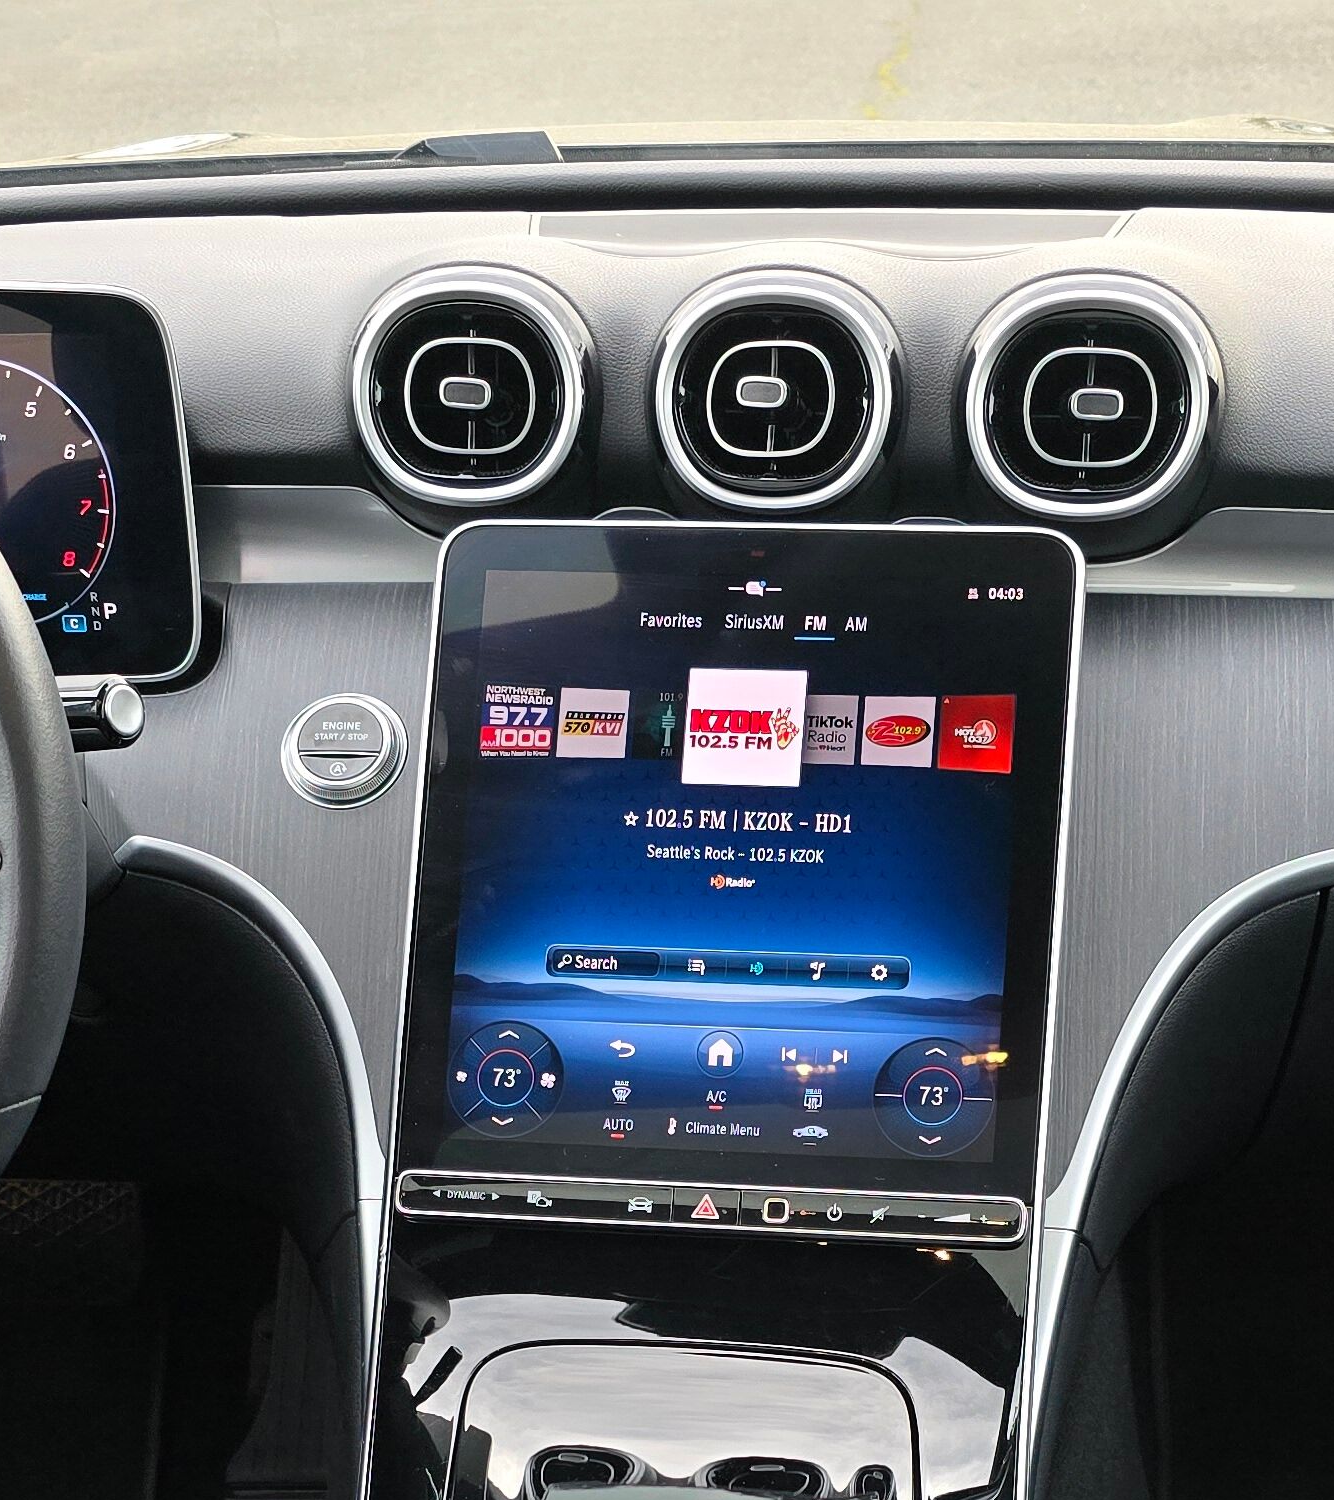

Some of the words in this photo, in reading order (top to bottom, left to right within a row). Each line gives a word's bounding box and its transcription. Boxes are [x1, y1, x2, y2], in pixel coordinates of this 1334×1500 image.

[24, 402, 37, 418] 5
[63, 444, 76, 460] 6
[80, 500, 92, 515] 7
[62, 552, 76, 567] 8
[90, 592, 98, 602] R
[988, 587, 1024, 601] 04:03
[91, 607, 100, 617] N
[103, 602, 117, 619] P
[69, 619, 79, 629] C
[93, 621, 102, 631] D
[640, 611, 702, 629] Favorites
[725, 613, 784, 632] SiriusXM
[804, 616, 827, 632] FM
[845, 616, 868, 633] AM
[486, 685, 546, 696] NORTHWEST
[485, 693, 554, 705] NEWSRADIO
[489, 705, 548, 726] 97.7
[690, 709, 774, 735] KZOK
[807, 715, 854, 729] TikTok
[322, 721, 361, 731] ENGINE
[563, 722, 591, 733] 570
[592, 721, 621, 735] KVI
[894, 725, 922, 736] 102.9
[314, 733, 338, 741] START
[348, 733, 369, 741] STOP
[494, 728, 551, 747] 1000
[689, 735, 739, 749] 102.5
[745, 736, 772, 750] FM
[807, 730, 847, 744] Radio
[645, 808, 694, 829] 102.5
[699, 809, 726, 830] FM
[743, 811, 794, 832] KZOK
[815, 813, 852, 834] HD1
[646, 843, 701, 860] Seattle's
[705, 846, 735, 861] Rock
[749, 847, 786, 863] 102.5
[790, 849, 825, 864] KZOK
[574, 955, 618, 971] Search
[706, 1089, 727, 1103] A/C
[603, 1118, 634, 1132] AUTO
[685, 1121, 727, 1136] Climate
[730, 1123, 760, 1137] Menu
[447, 1189, 486, 1201] DYNAMIC
